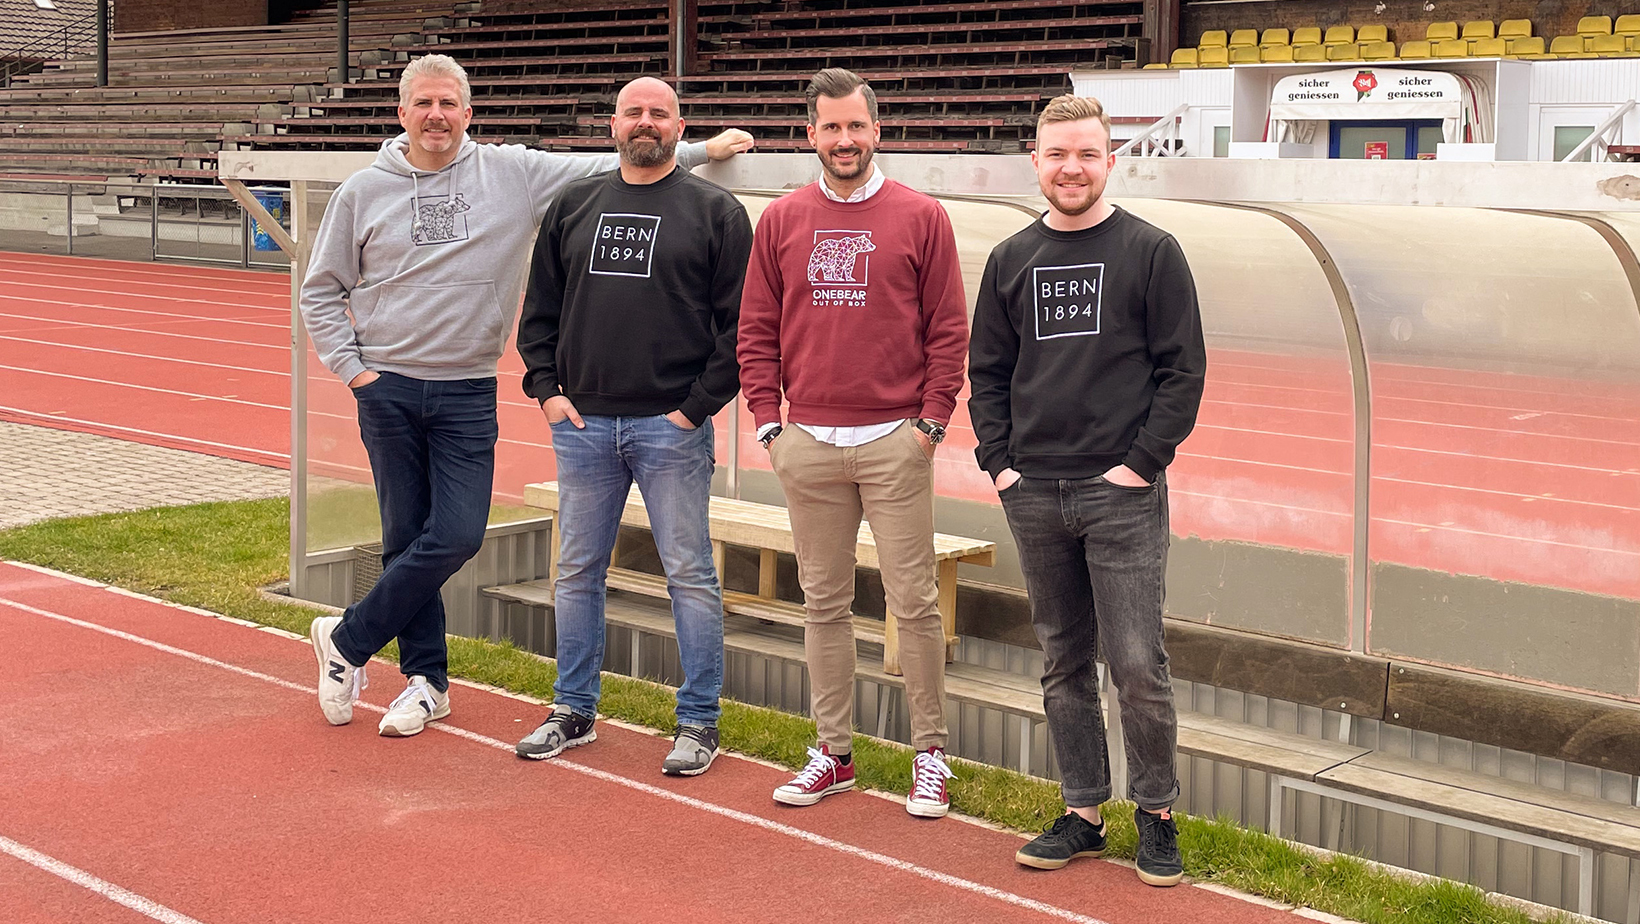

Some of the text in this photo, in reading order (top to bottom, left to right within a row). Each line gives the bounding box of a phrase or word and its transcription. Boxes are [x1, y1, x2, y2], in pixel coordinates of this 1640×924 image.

[1298, 78, 1330, 88] sicher
[1398, 76, 1433, 86] sicher
[1288, 90, 1340, 101] geniessen
[1387, 89, 1443, 100] geniessen
[601, 225, 653, 242] BERN
[600, 245, 645, 261] 1894
[812, 289, 867, 300] ONEBEAR
[1041, 278, 1097, 298] BERN
[1043, 302, 1092, 322] 1894
[328, 660, 346, 684] N
